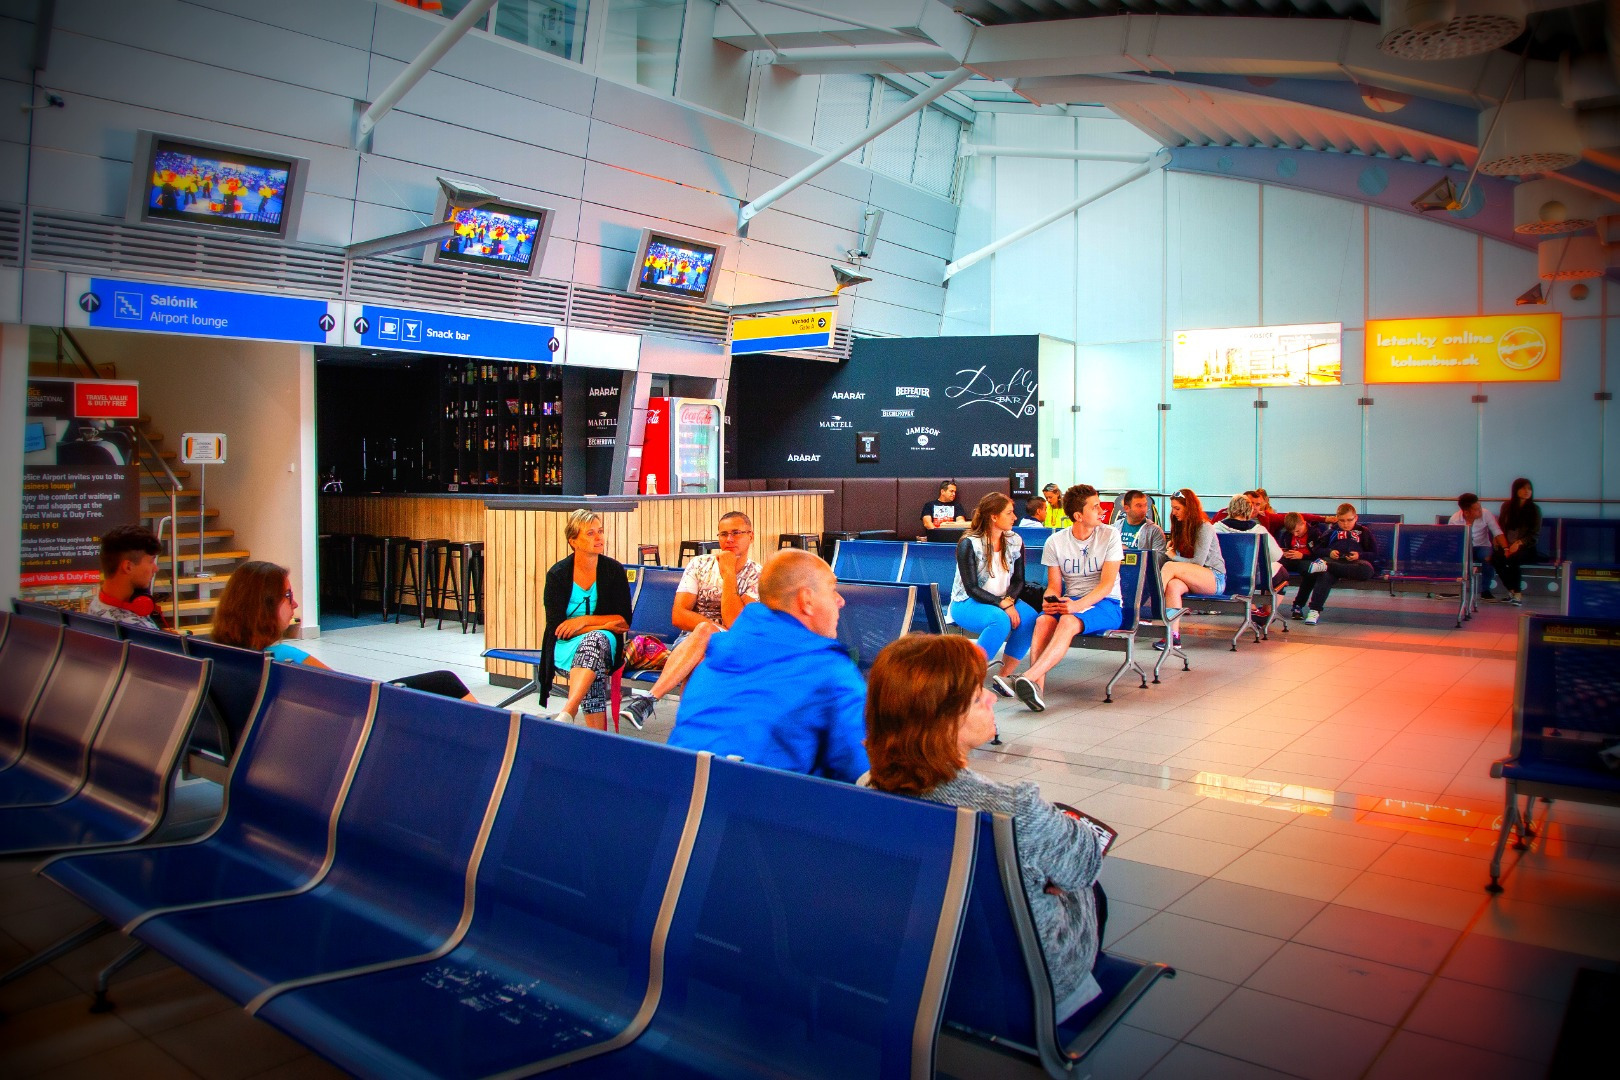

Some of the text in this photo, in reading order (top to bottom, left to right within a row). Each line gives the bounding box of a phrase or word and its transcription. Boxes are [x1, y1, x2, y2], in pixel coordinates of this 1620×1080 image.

[151, 294, 198, 308] Salónik
[150, 312, 228, 327] Airport lounge
[427, 328, 470, 340] Snack bar
[1377, 334, 1436, 348] letenky
[1443, 331, 1494, 345] online
[832, 391, 865, 400] ARARAT
[896, 386, 930, 398] BEEFEATER
[994, 396, 1020, 404] BAR
[906, 427, 940, 436] JAMESON
[972, 444, 1034, 458] ABSOLUT.
[787, 453, 821, 462] ARARAT
[51, 502, 81, 510] shopping
[69, 511, 85, 519] Duty
[1574, 628, 1597, 636] HOTEL
